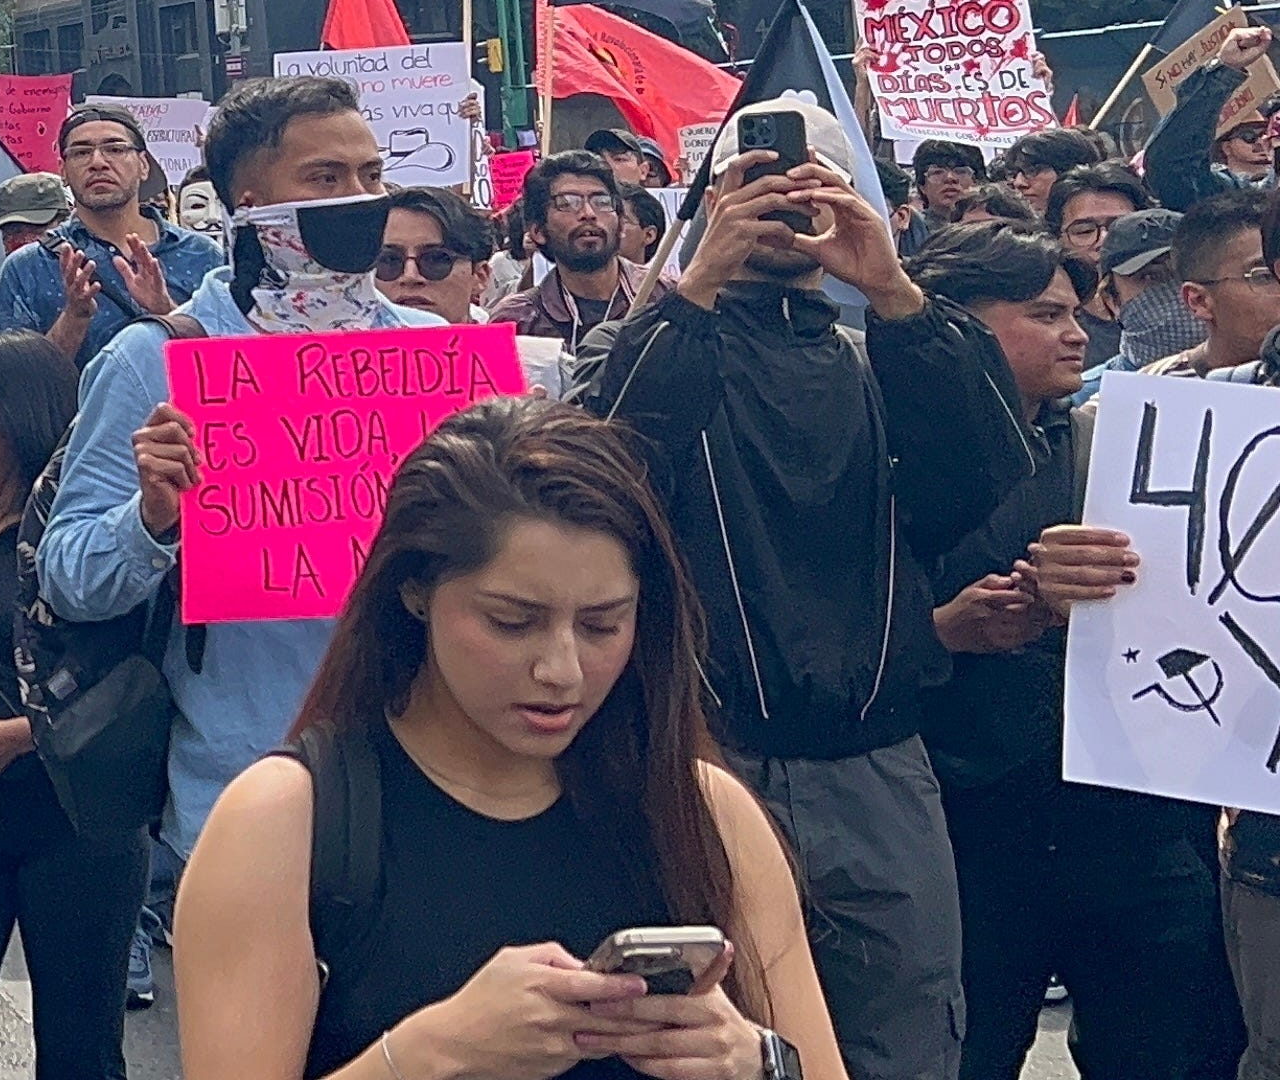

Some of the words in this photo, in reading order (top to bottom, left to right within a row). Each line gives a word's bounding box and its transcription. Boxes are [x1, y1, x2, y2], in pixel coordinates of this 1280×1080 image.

[306, 51, 389, 77] voluntad
[400, 47, 432, 70] del
[903, 36, 1005, 64] TODOS
[360, 79, 386, 93] no
[391, 73, 454, 91] muere
[877, 69, 952, 94] DÍAS
[998, 68, 1031, 90] DE
[359, 103, 384, 122] ás
[392, 103, 433, 119] viva
[878, 90, 1055, 127] MUERTOS
[193, 349, 261, 406] LA
[295, 335, 499, 402] REBELDÍA
[203, 421, 257, 472] ES
[279, 409, 399, 467] VIDA,
[262, 543, 327, 600] LA
